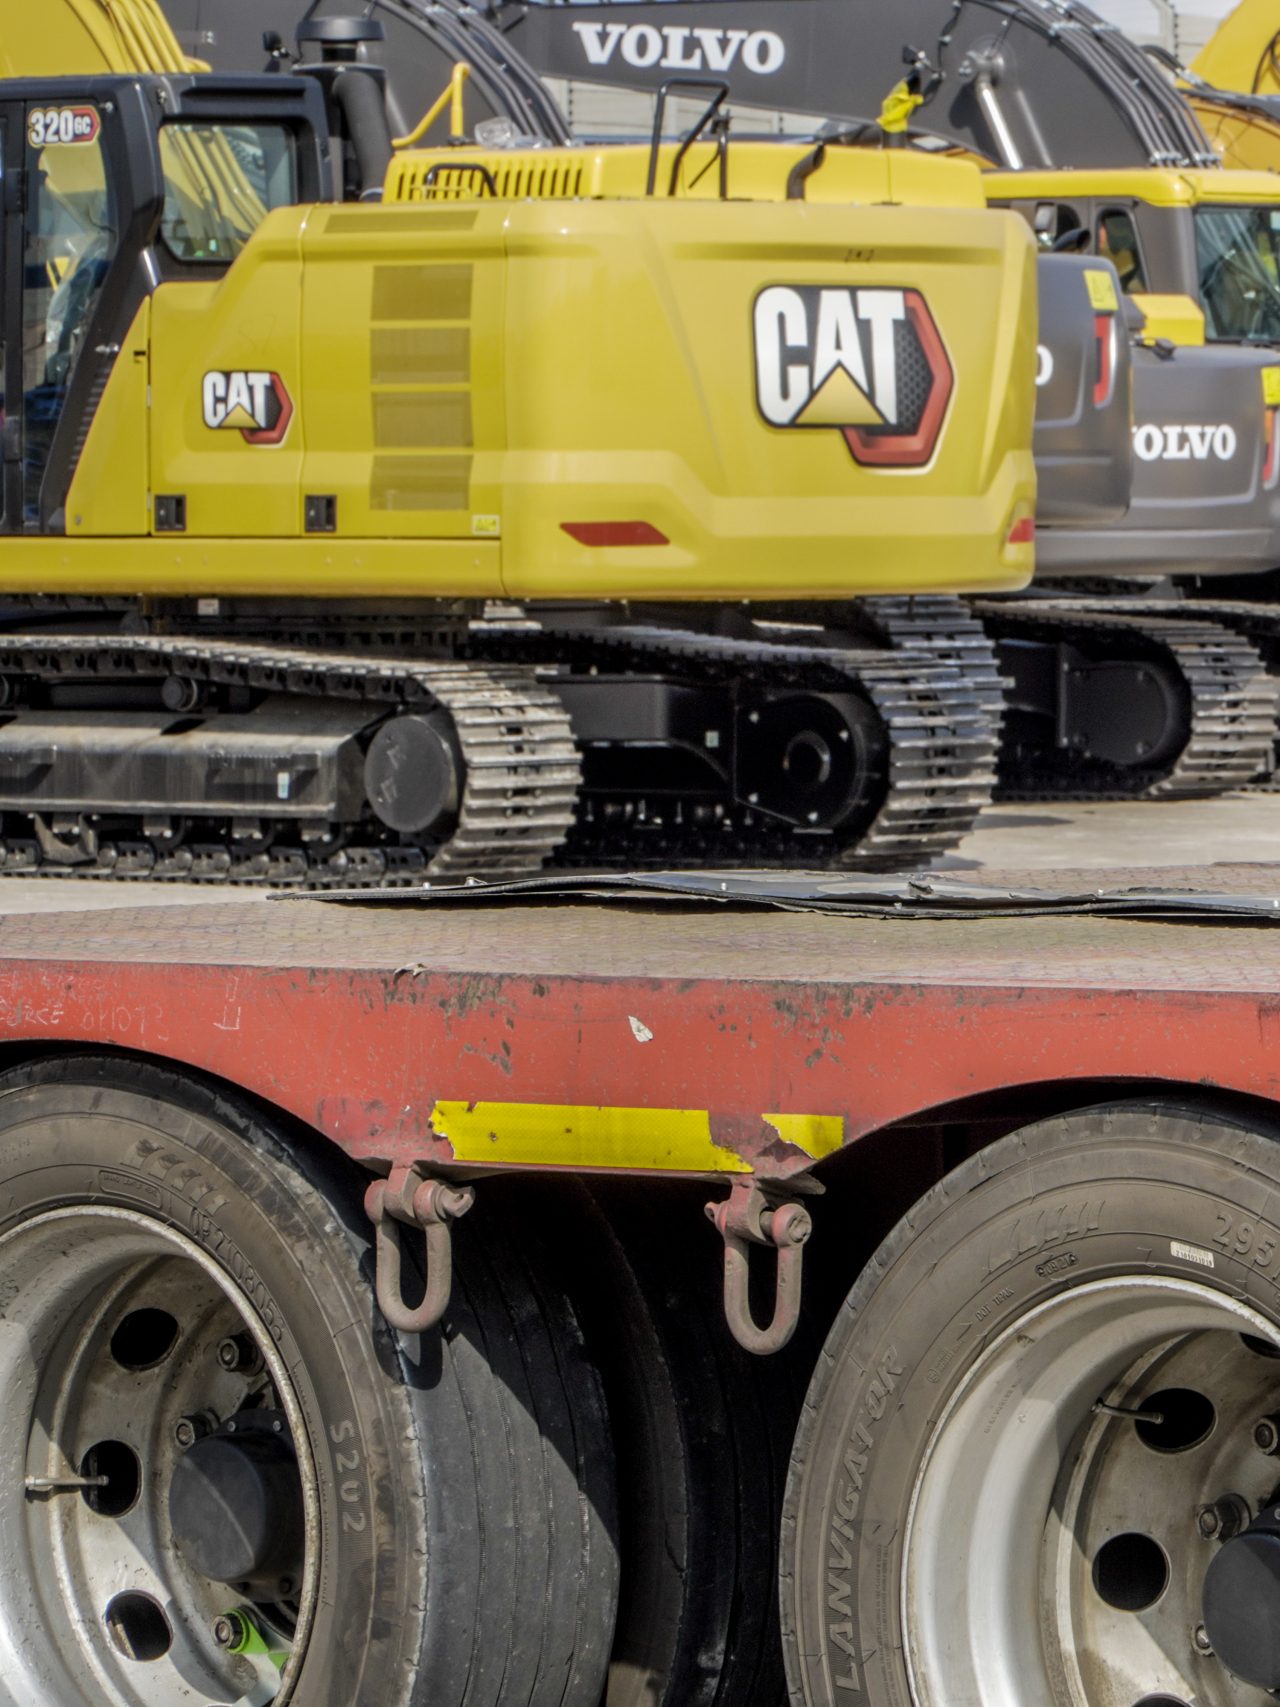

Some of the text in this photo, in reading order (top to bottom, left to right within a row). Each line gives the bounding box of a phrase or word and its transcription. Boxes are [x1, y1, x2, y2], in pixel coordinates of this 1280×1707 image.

[572, 20, 786, 74] VOLVO
[31, 109, 74, 144] 320
[755, 286, 906, 426] CAT
[203, 370, 273, 429] CAT
[1131, 423, 1237, 461] OLVO
[329, 1419, 368, 1534] S202
[828, 1343, 908, 1691] LANVIGATOR
